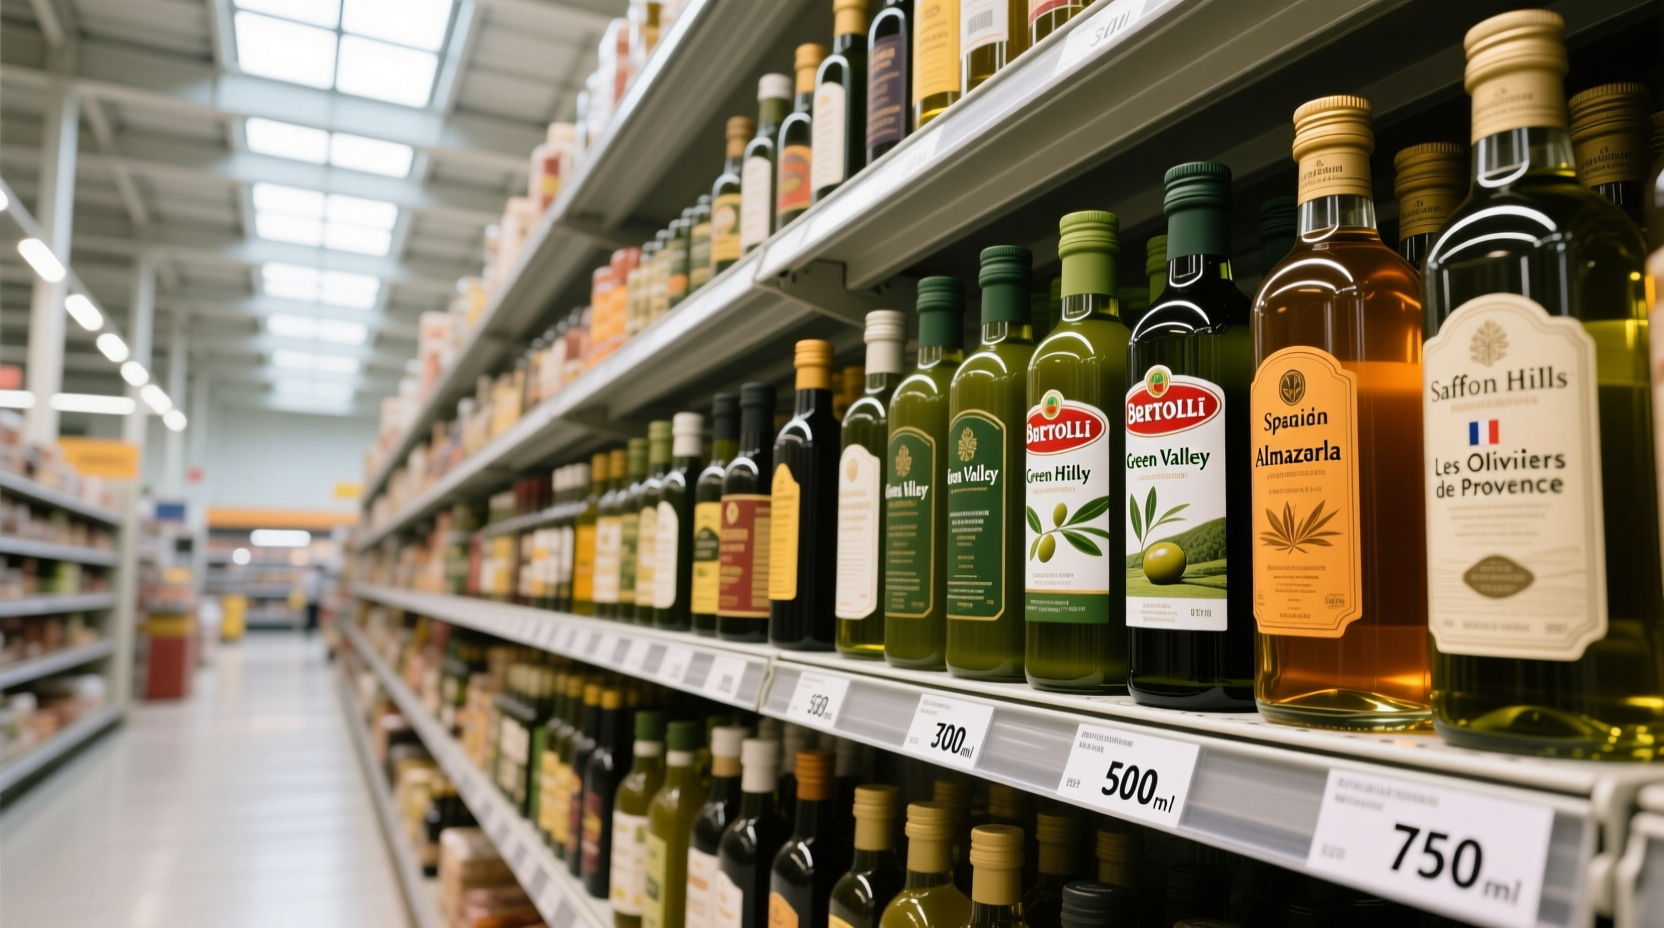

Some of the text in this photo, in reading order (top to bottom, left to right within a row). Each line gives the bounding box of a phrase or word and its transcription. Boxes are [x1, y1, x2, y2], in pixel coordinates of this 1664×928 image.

[1430, 365, 1569, 403] Saffon Hills
[1159, 446, 1211, 471] Valley
[1435, 457, 1461, 477] Les
[1055, 464, 1091, 485] Hilly
[1436, 477, 1565, 499] de Provence
